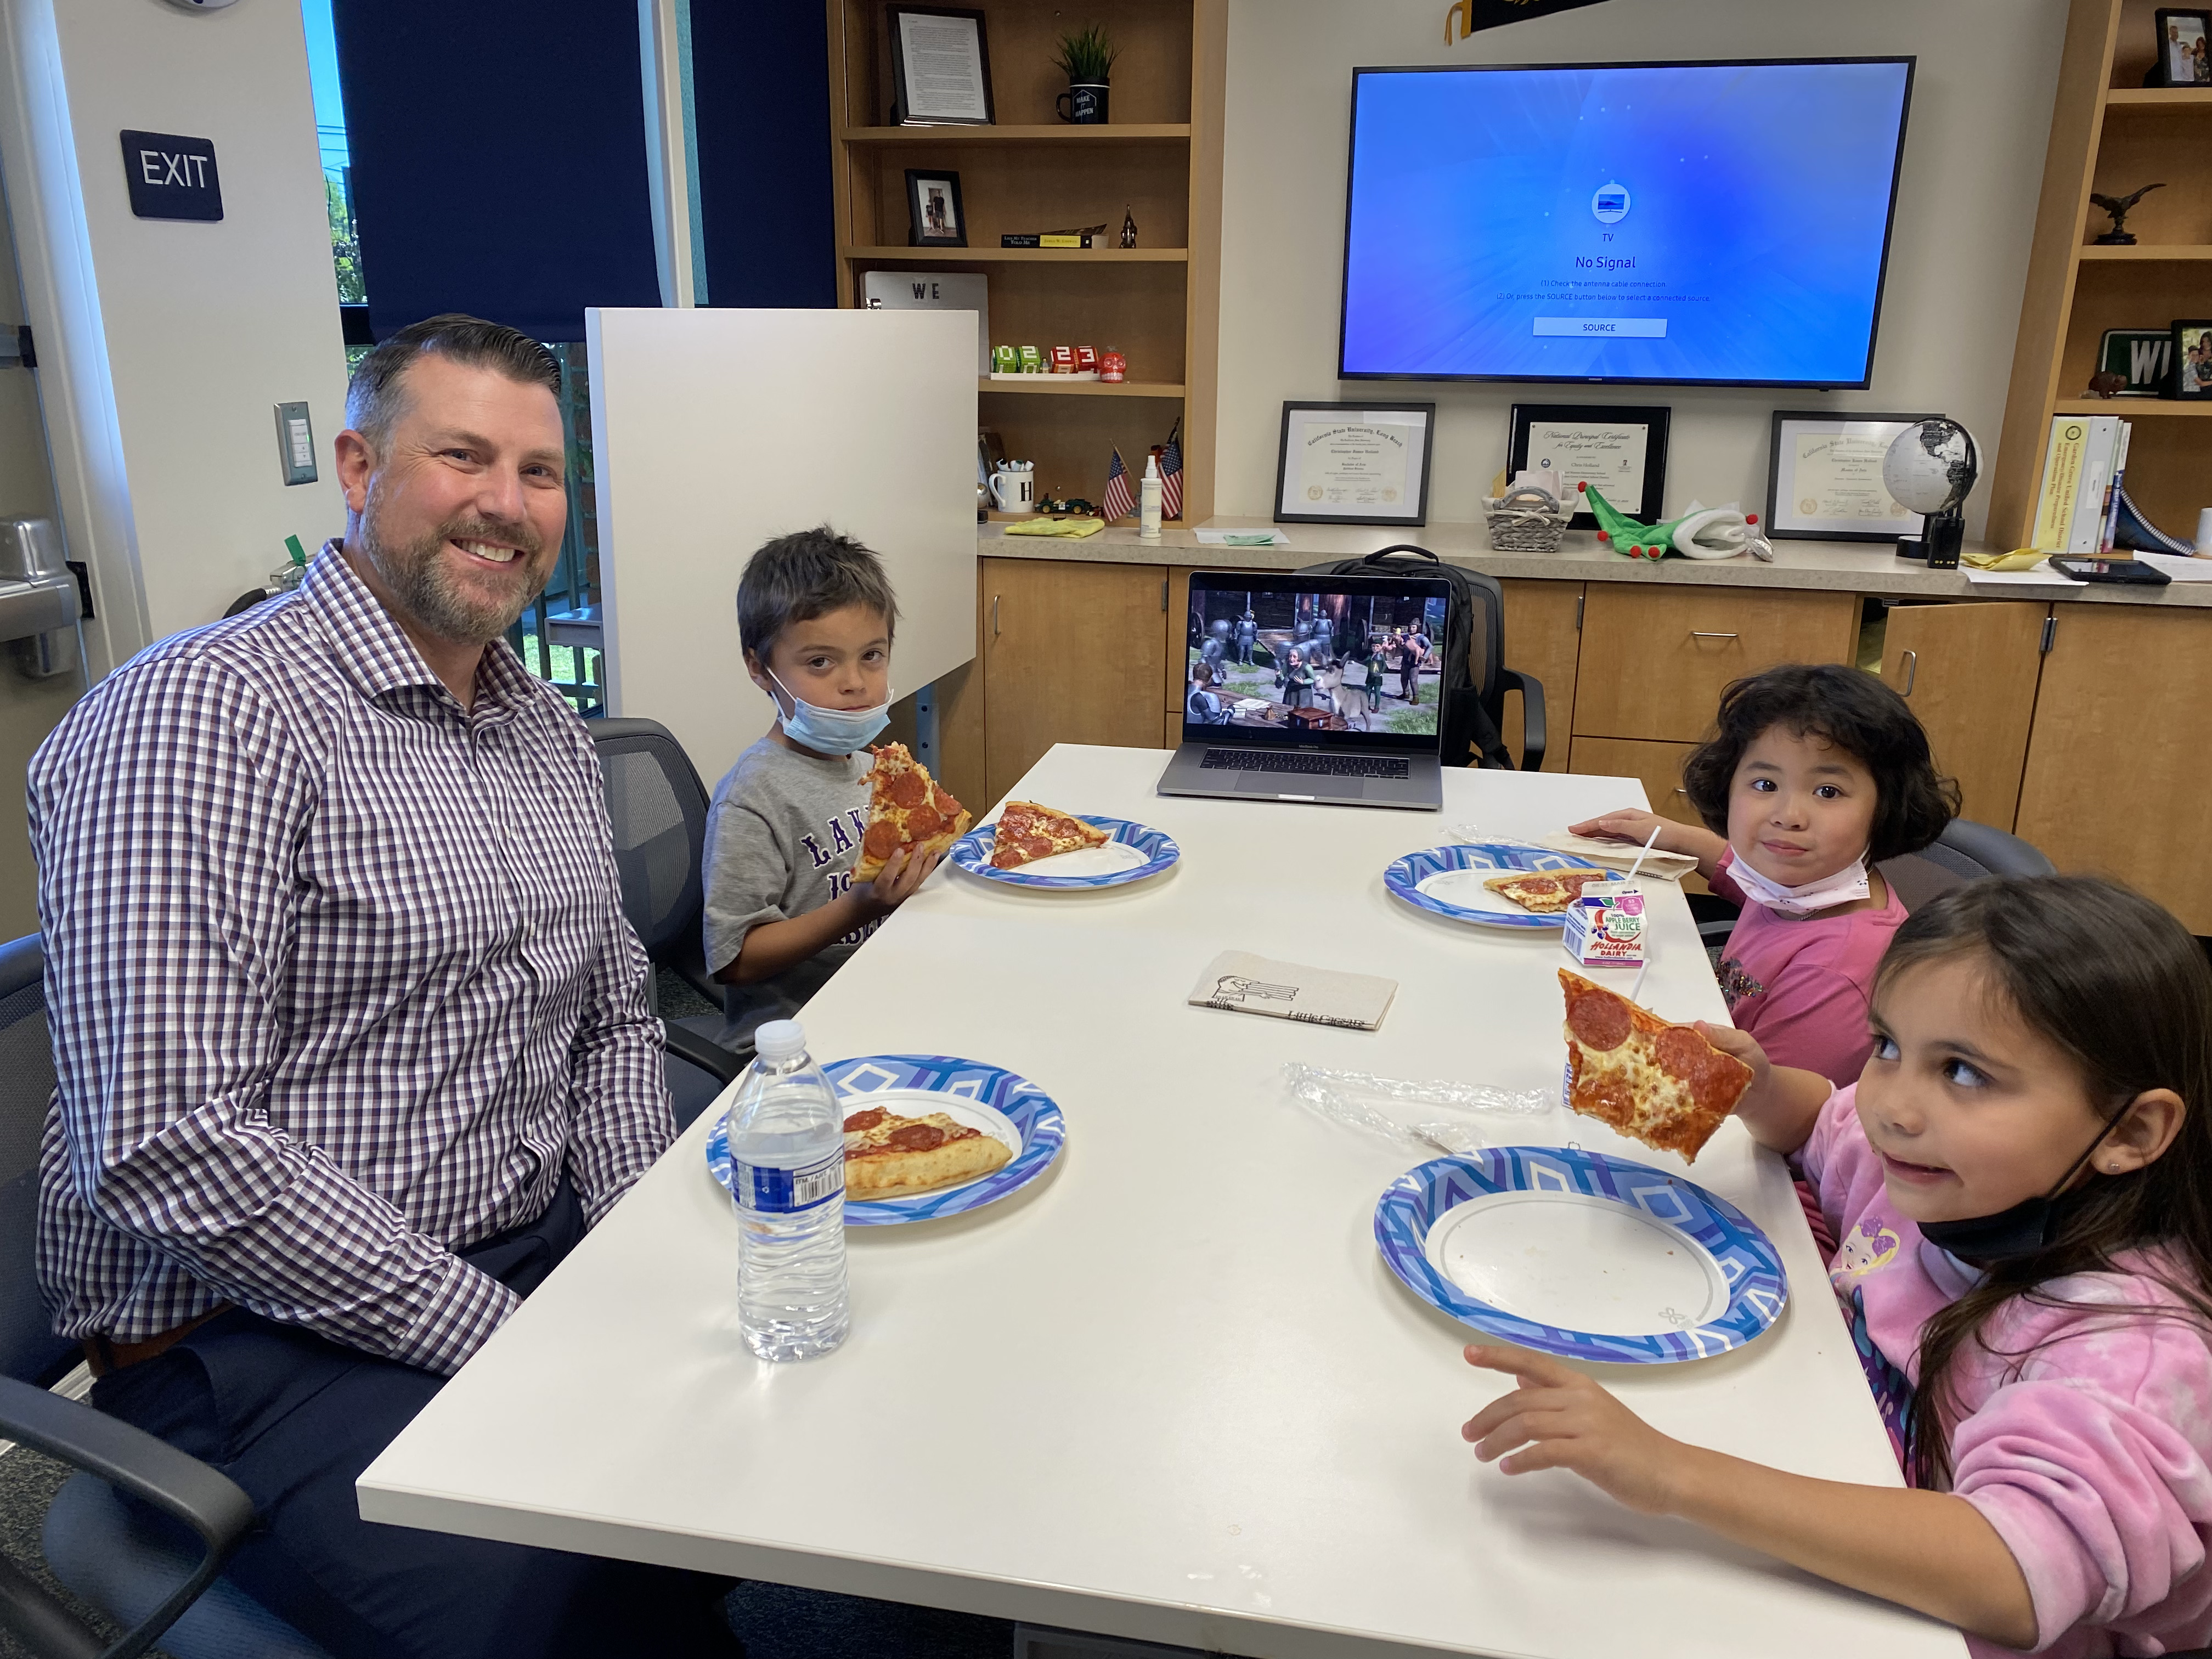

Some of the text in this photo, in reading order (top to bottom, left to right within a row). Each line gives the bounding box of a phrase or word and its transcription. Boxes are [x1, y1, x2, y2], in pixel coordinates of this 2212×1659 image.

[140, 150, 208, 188] EXIT
[1602, 233, 1614, 242] TV
[1576, 256, 1636, 271] No Signal
[1582, 323, 1616, 332] SOURCE
[1307, 431, 1331, 446] California
[1376, 430, 1389, 439] Long
[1390, 435, 1403, 448] Beach
[1572, 431, 1601, 442] Principal
[1802, 444, 1827, 459] California
[2070, 443, 2080, 464] Garden
[2067, 466, 2075, 483] Grove
[1020, 481, 1032, 502] H
[1615, 923, 1641, 931] JUICE
[1590, 941, 1642, 951] HOLLANDIA
